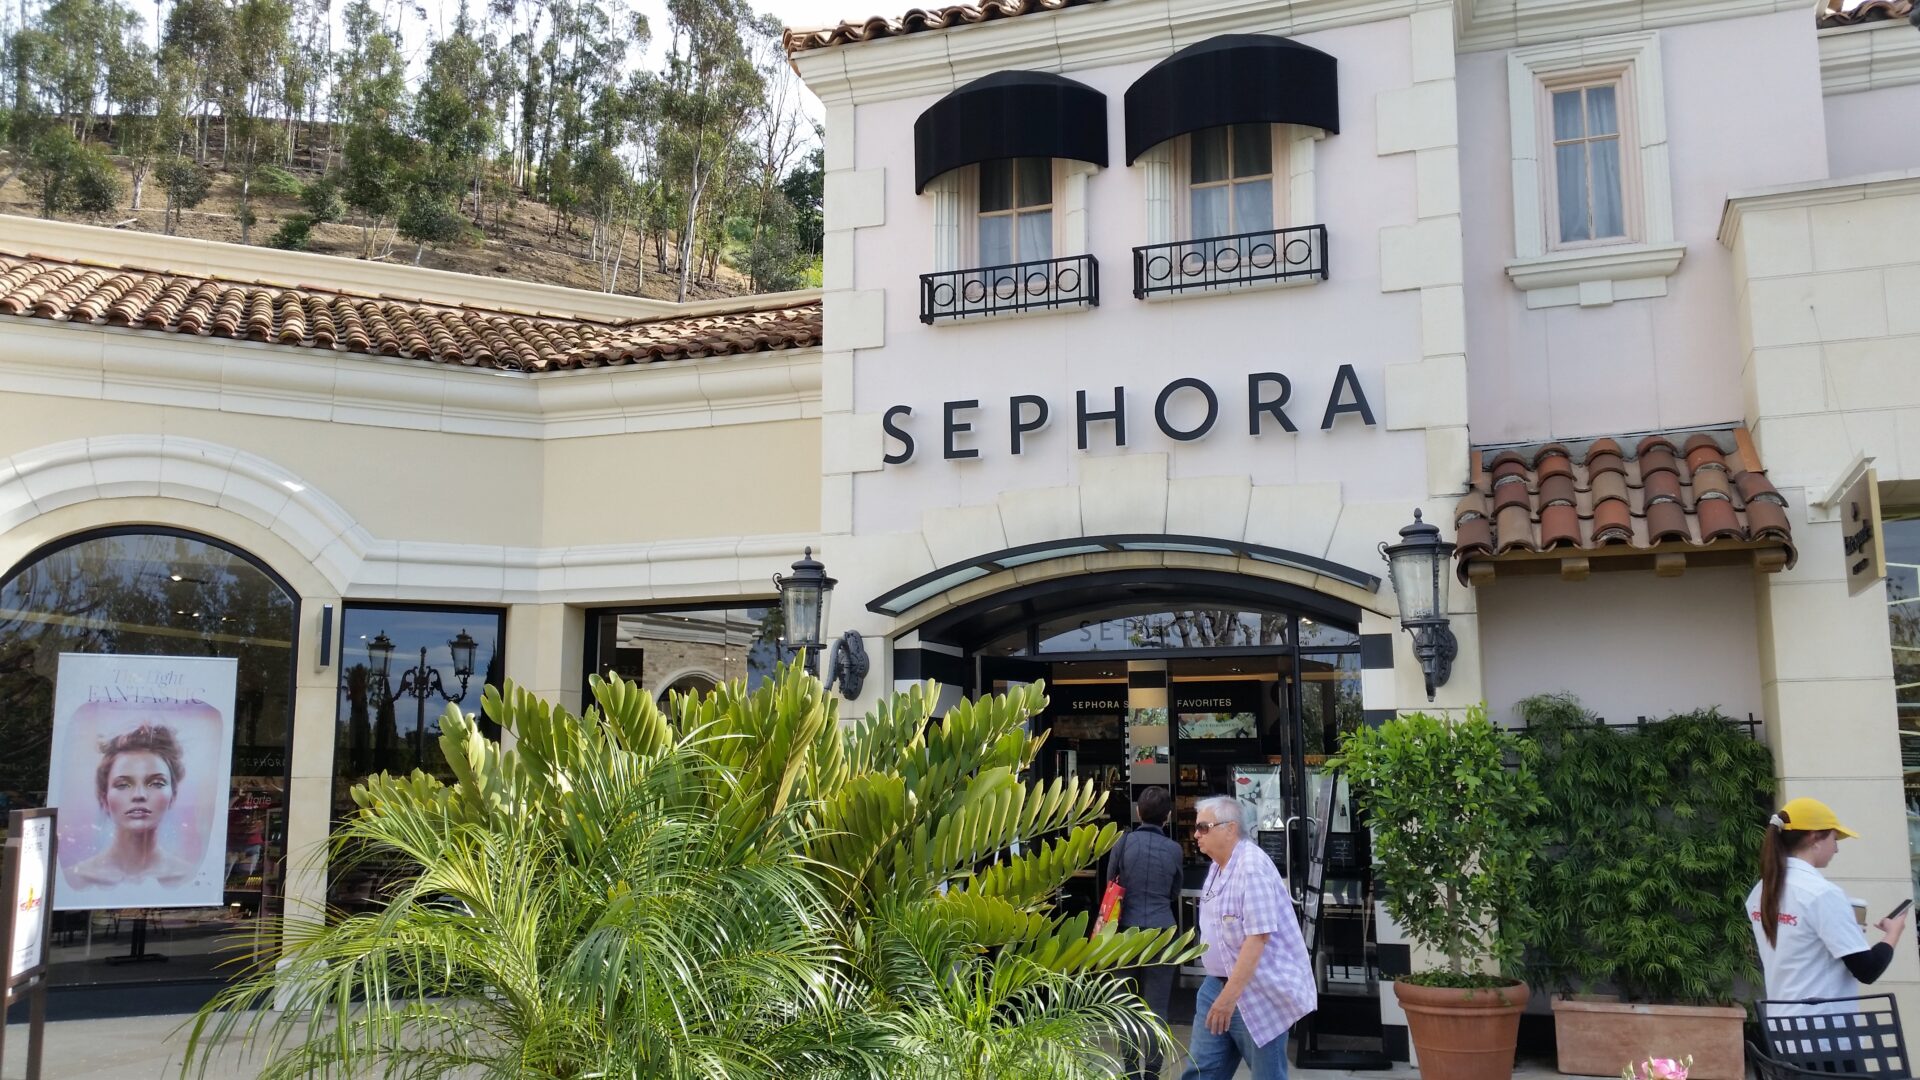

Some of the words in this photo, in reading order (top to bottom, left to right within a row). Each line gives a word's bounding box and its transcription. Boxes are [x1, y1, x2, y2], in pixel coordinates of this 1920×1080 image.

[882, 364, 1378, 466] SEPHORA
[1079, 614, 1242, 642] SEPHORA
[146, 669, 185, 688] Light
[88, 684, 206, 705] FANTASTIC
[1072, 701, 1120, 709] SEPHORA
[1177, 698, 1232, 708] FAVORITES
